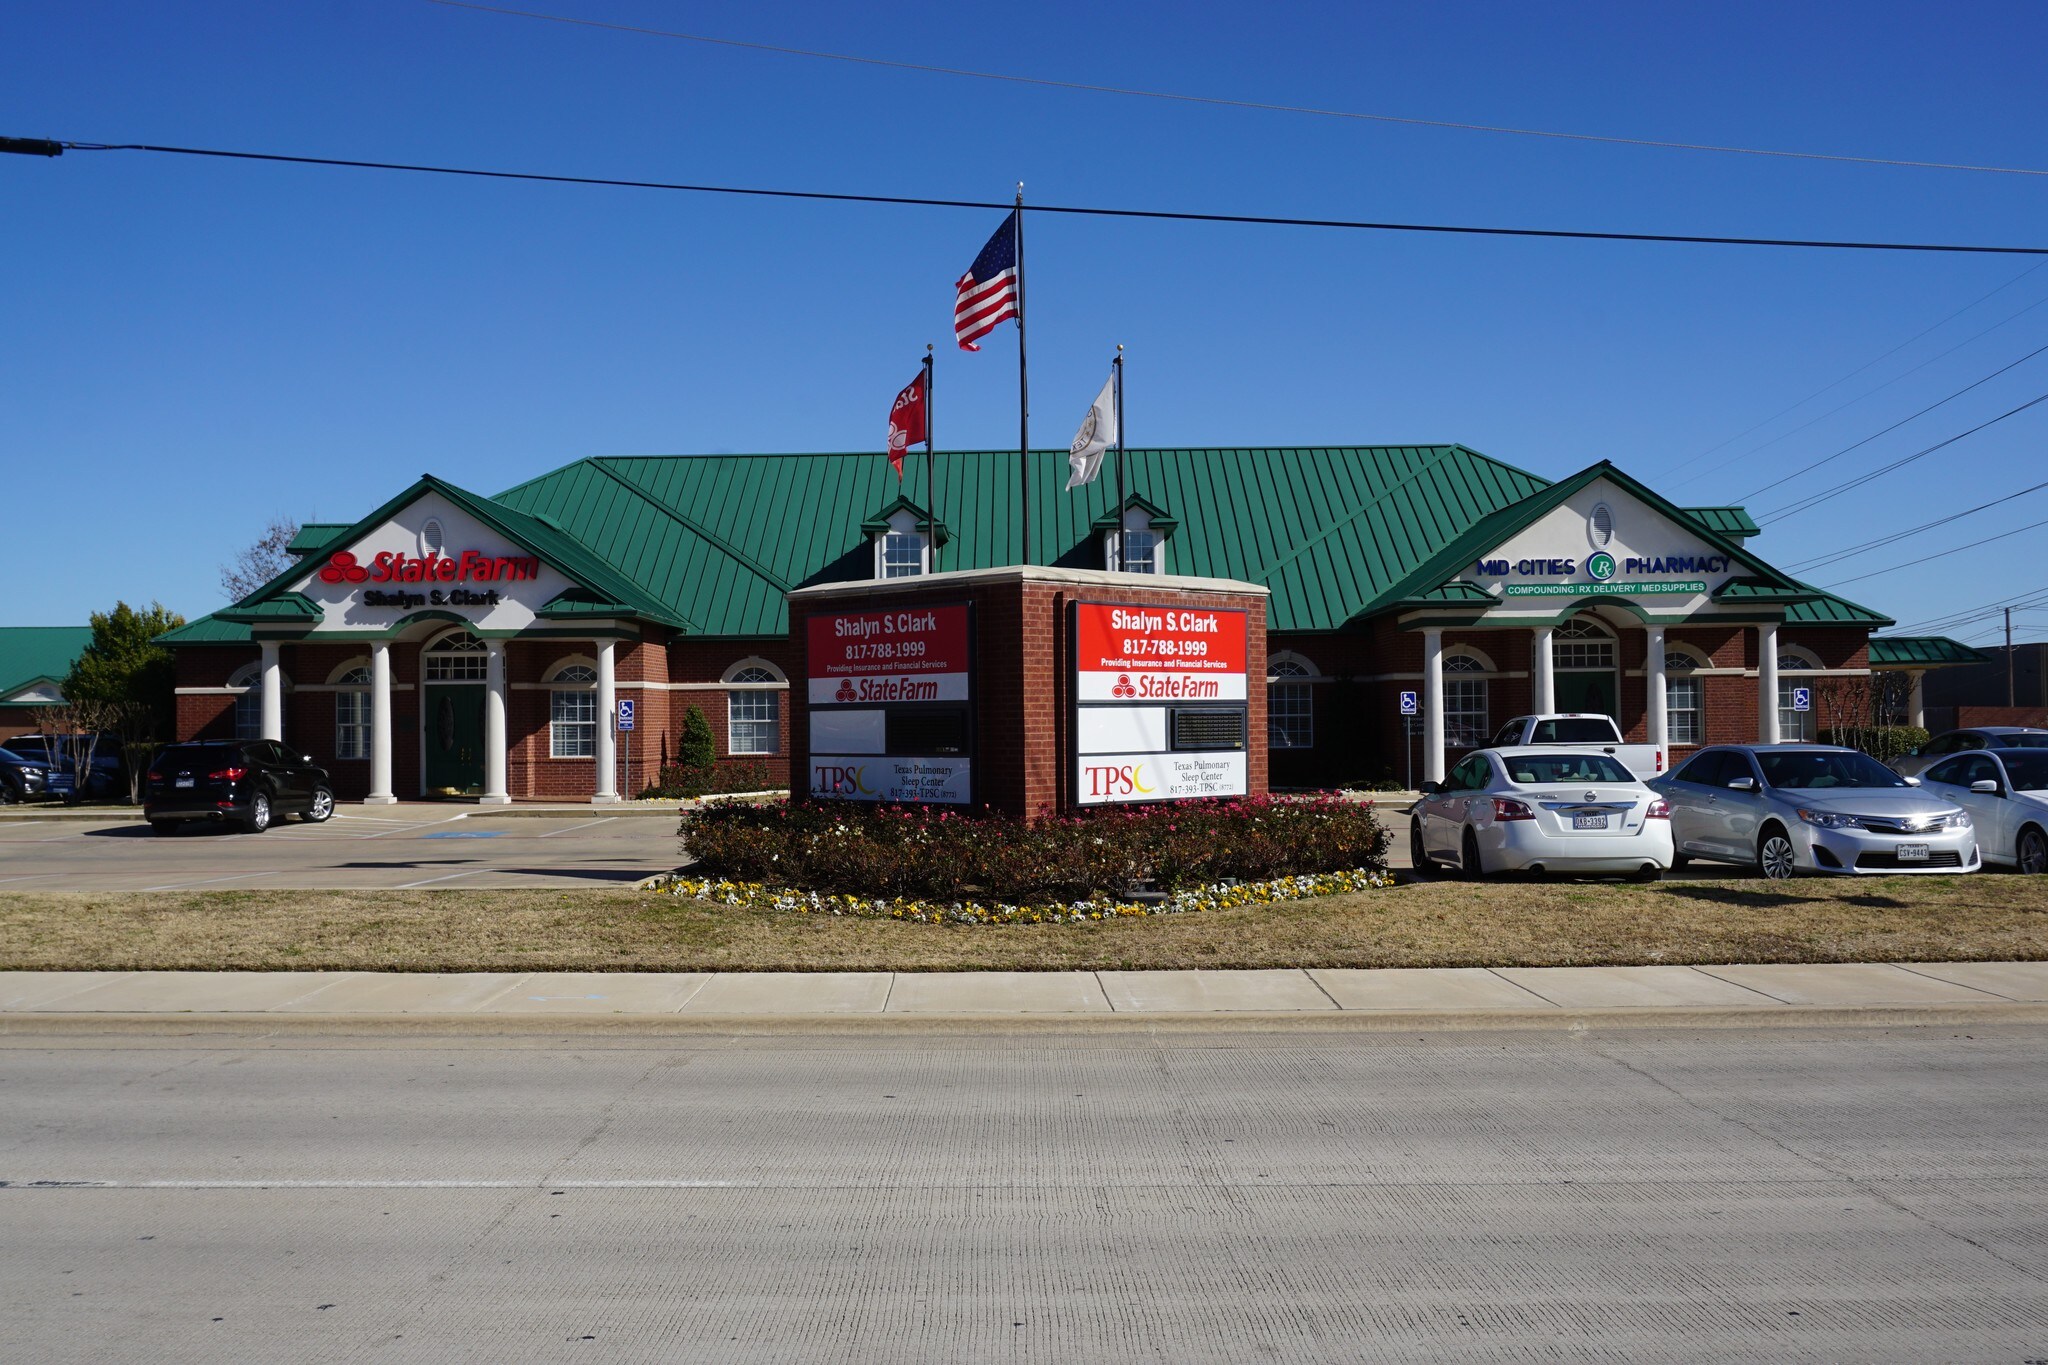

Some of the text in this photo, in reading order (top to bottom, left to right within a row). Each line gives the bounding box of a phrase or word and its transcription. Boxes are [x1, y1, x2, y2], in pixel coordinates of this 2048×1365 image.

[1476, 558, 1576, 576] MID-CITIES
[1626, 556, 1731, 574] PHARMACY
[1508, 585, 1574, 595] COMPOUNDING
[1579, 585, 1591, 593] RX
[1593, 584, 1636, 593] DELIVERY
[363, 589, 426, 610] Shalyn
[450, 589, 500, 606] Clark
[835, 612, 937, 640] Shalyn S. Clark
[1112, 609, 1218, 635] Shalyn S. Clark
[846, 641, 926, 660] 817-788-1999
[1123, 639, 1208, 656] 817-788-1999
[826, 660, 948, 673] Providing Insurance and Financial Services
[1101, 658, 1228, 669] Providing Insurance and Financial Services
[894, 764, 953, 777] Texas Pulmonary
[1174, 760, 1231, 771] Texas Pulmonary
[901, 776, 945, 788] Sleep Center
[1181, 772, 1223, 783] Sleep Center
[1170, 783, 1218, 794] 817-393-TPSC
